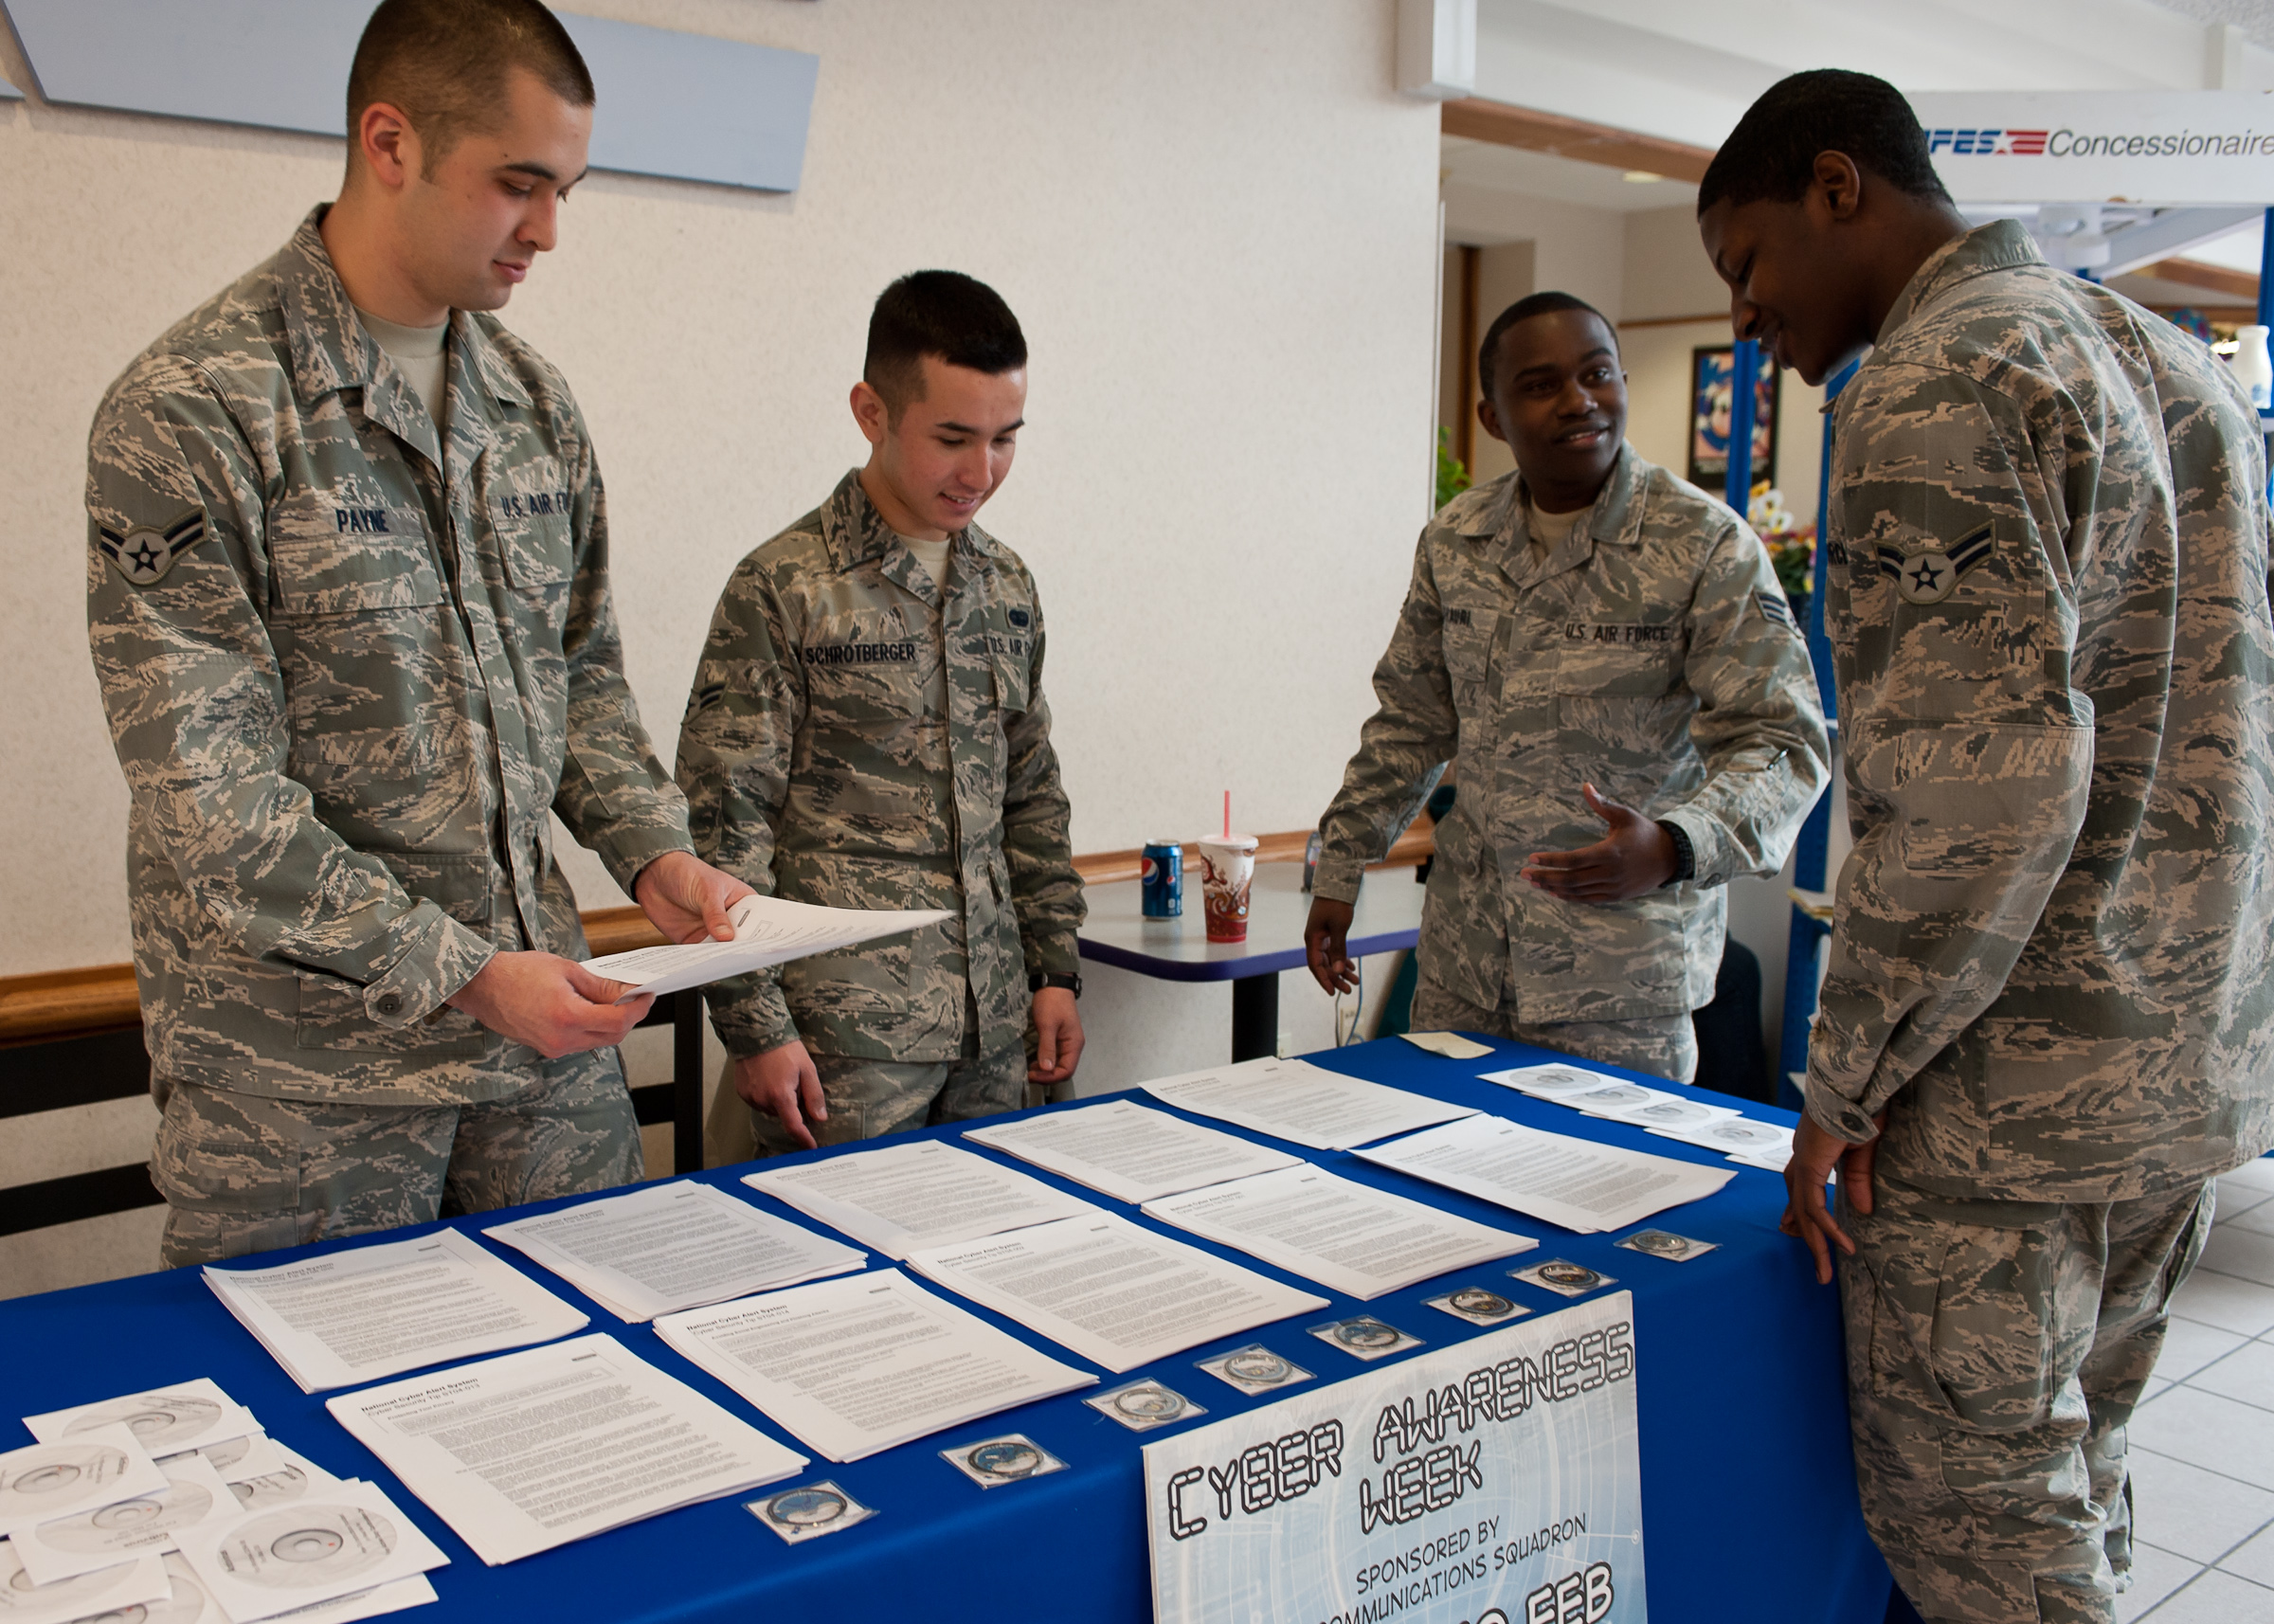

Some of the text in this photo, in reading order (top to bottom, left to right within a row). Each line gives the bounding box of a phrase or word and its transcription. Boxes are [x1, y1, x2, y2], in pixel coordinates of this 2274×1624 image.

[2048, 129, 2274, 156] Concessionaire
[529, 492, 554, 514] AIR
[335, 509, 389, 532] PAYNE
[1565, 623, 1671, 642] U.S. AIR FORCE
[805, 642, 916, 664] SCHROTBERGER
[1008, 637, 1023, 657] AIR
[686, 1320, 717, 1331] National
[718, 1314, 740, 1324] Cyber
[760, 1305, 787, 1314] System
[694, 1326, 714, 1336] Cyber
[715, 1321, 744, 1330] Security
[361, 1378, 478, 1412] National Cyber Alert System
[368, 1407, 392, 1416] Cyber
[394, 1398, 426, 1410] Security
[1167, 1321, 1633, 1541] CYBER AWARENESS
[1360, 1439, 1482, 1535] WEEK
[1493, 1512, 1587, 1571] SQUADRON
[1356, 1515, 1500, 1595] SPONSORED BY
[1525, 1561, 1615, 1624] FEB
